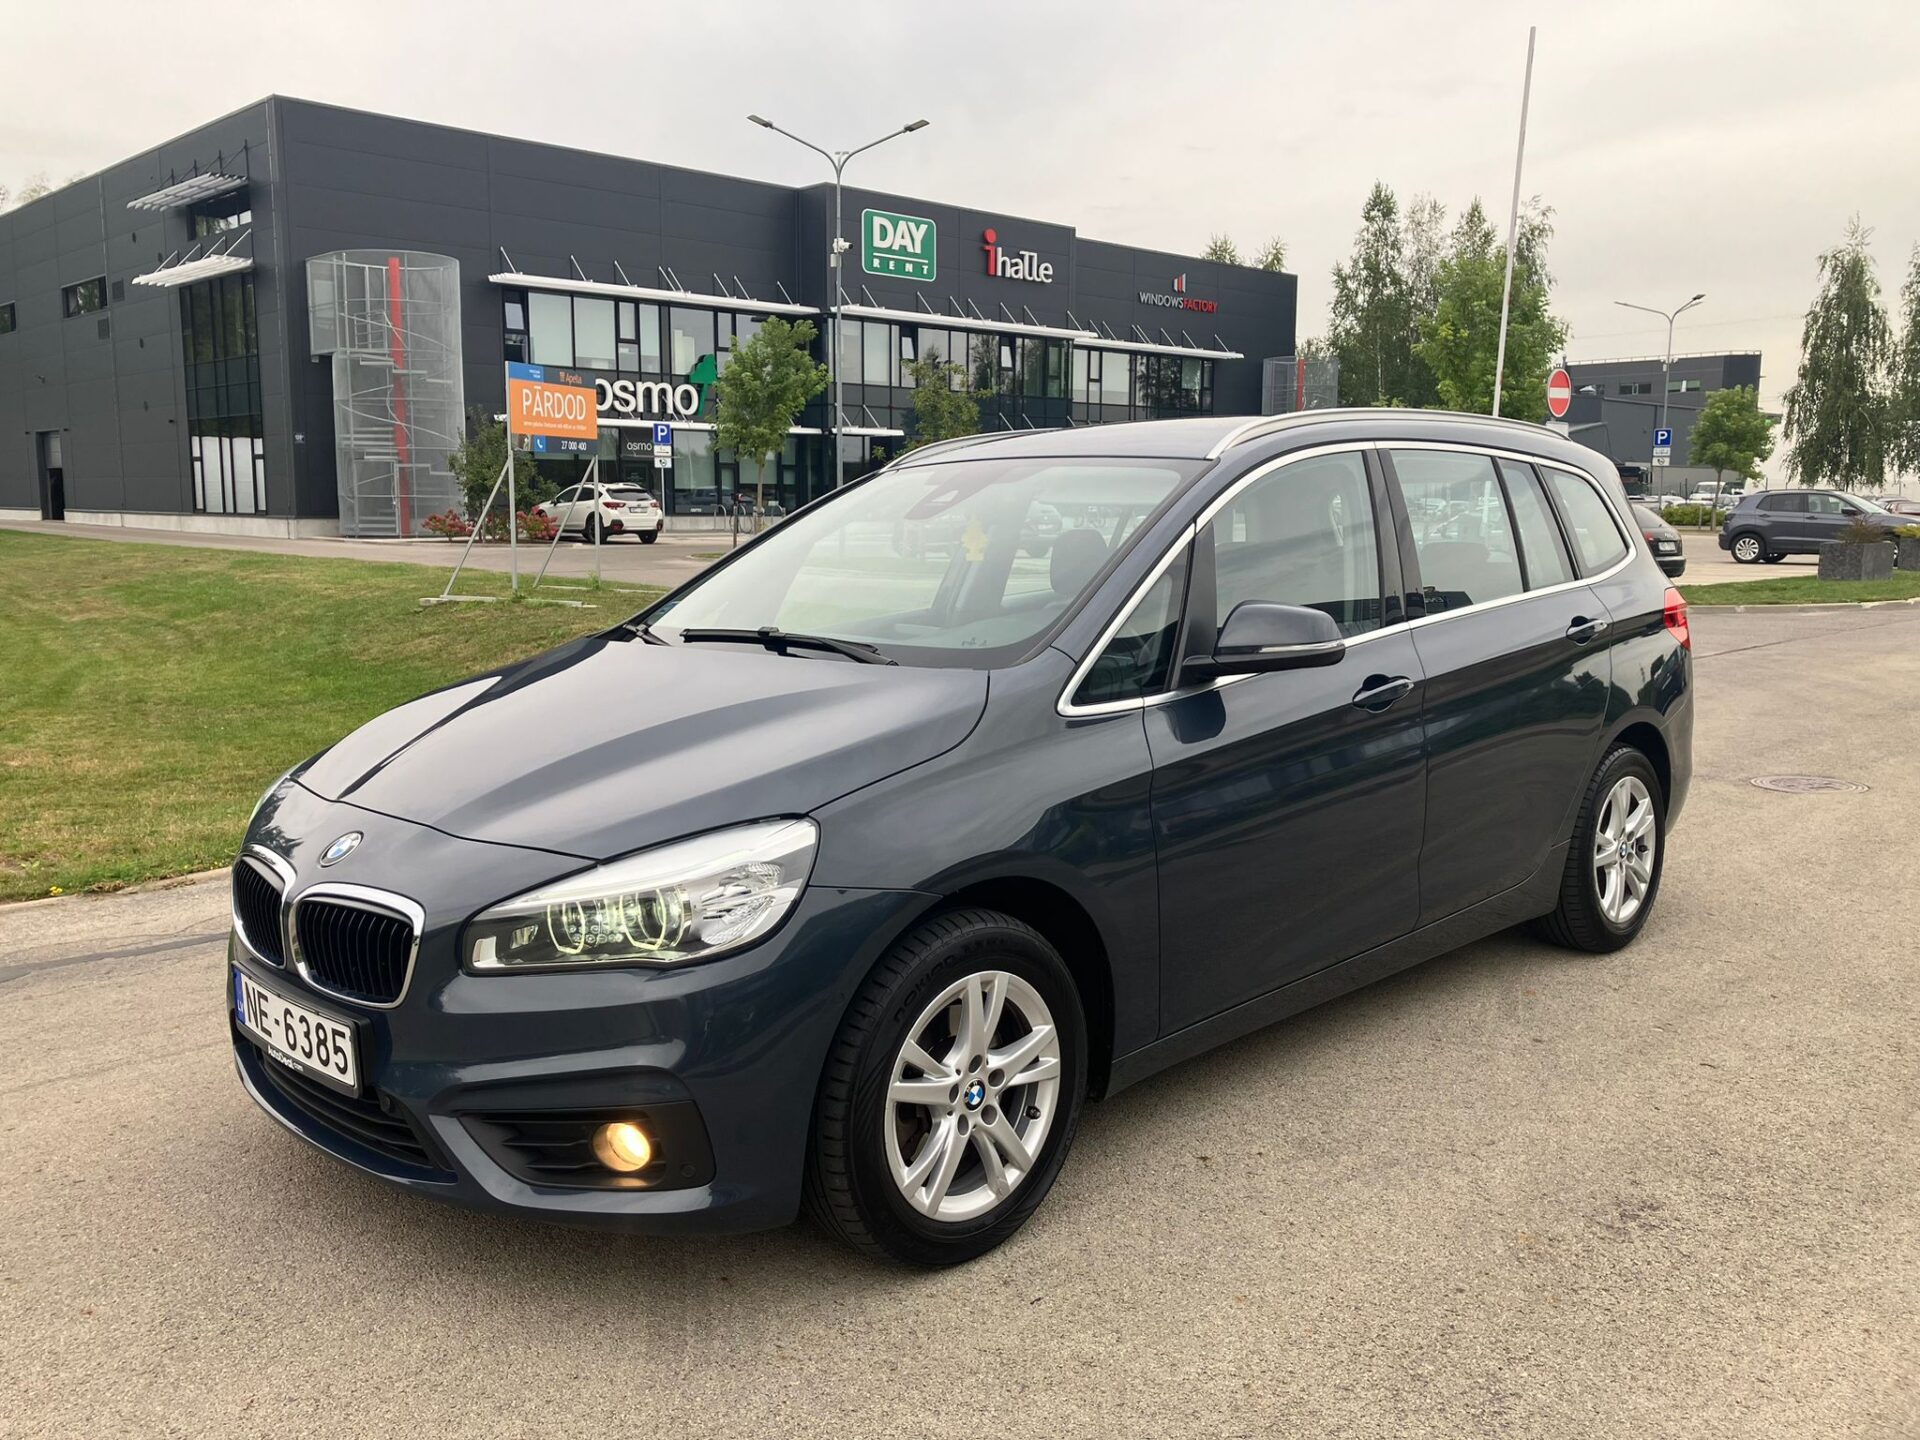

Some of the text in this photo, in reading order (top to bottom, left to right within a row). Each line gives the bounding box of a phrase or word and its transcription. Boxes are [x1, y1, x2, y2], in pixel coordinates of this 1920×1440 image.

[872, 216, 928, 254] DAY
[872, 258, 928, 274] RENT
[983, 228, 1053, 283] ihalle
[522, 385, 586, 420] PĀRDOD
[595, 378, 699, 415] osmo
[568, 441, 577, 450] 000
[657, 425, 667, 441] P
[1657, 431, 1668, 444] P
[627, 441, 653, 451] osmo
[244, 981, 349, 1075] NE-6385
